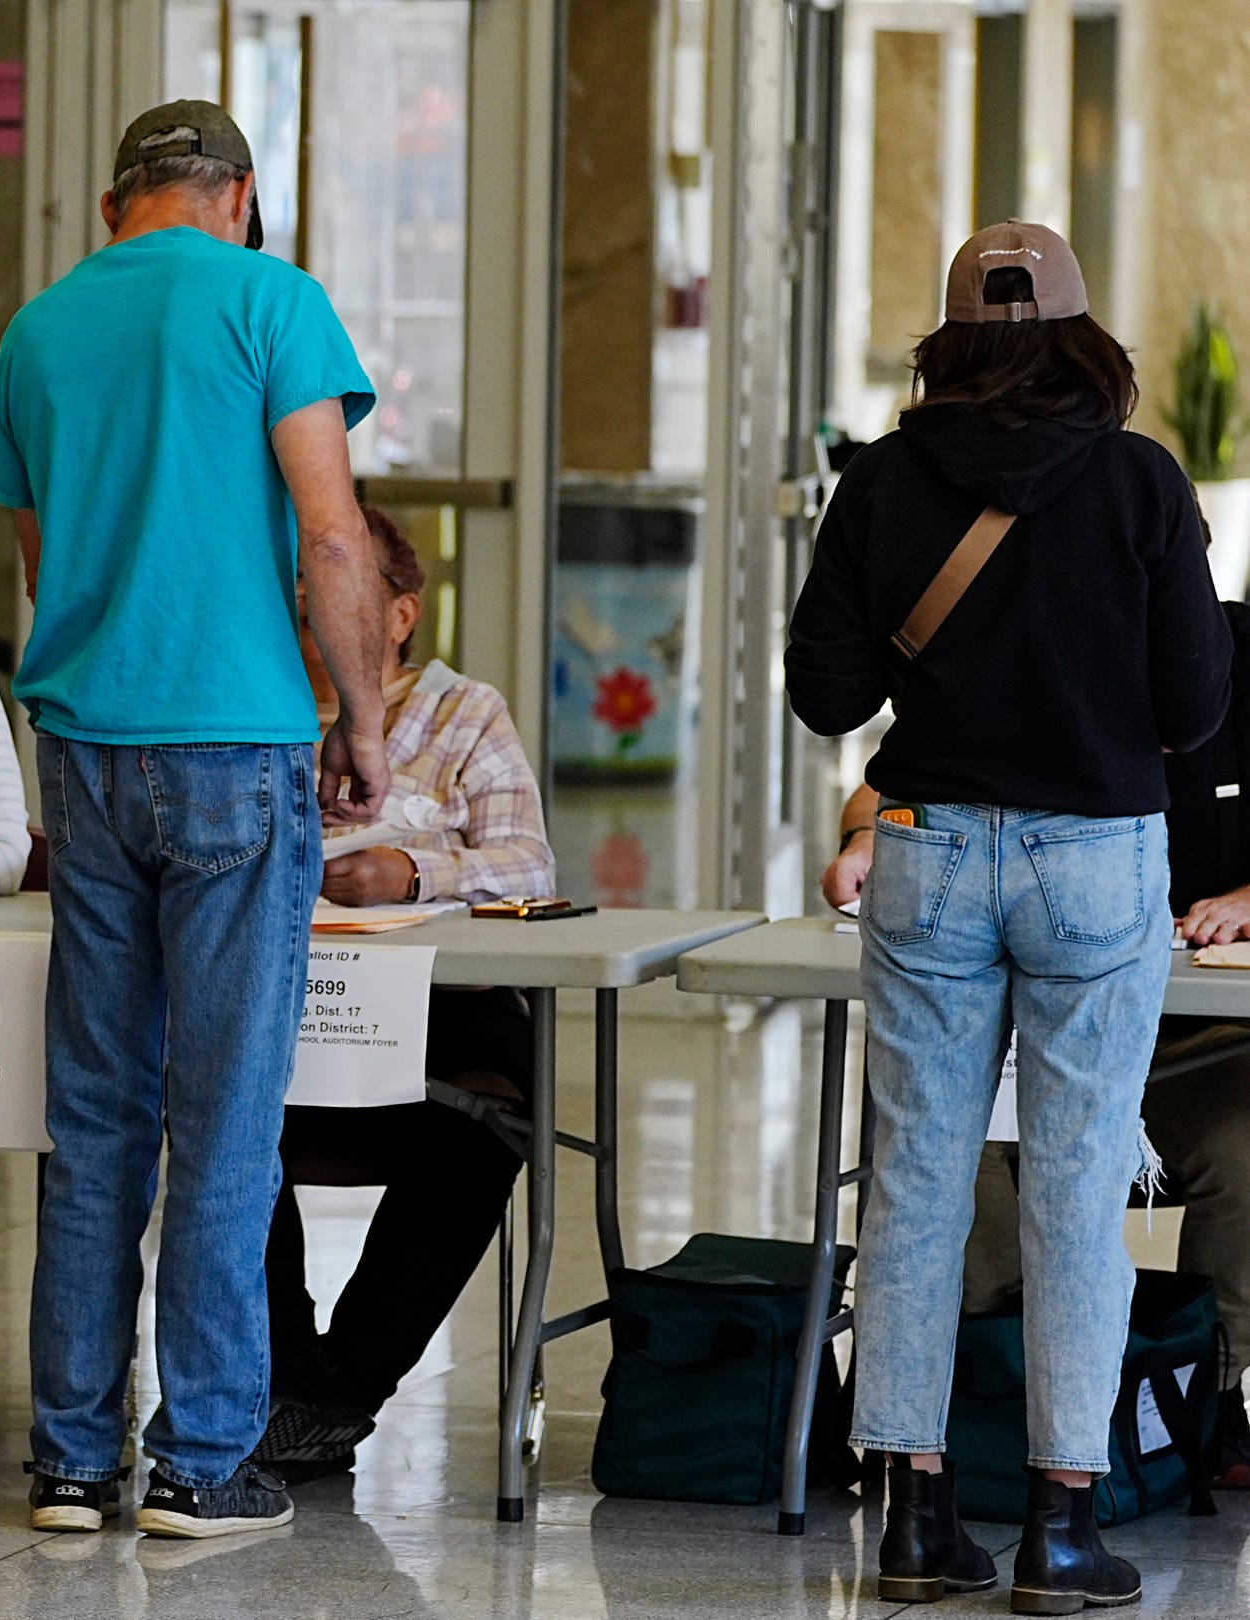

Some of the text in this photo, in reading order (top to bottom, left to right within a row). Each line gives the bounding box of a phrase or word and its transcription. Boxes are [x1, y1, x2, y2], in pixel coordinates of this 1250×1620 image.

[308, 951, 333, 961] allot
[336, 952, 350, 961] ID
[305, 979, 346, 996] 5699
[315, 1004, 343, 1017] Dist.
[348, 1007, 361, 1017] 17
[320, 1021, 368, 1034] District:
[372, 1025, 379, 1034] 7
